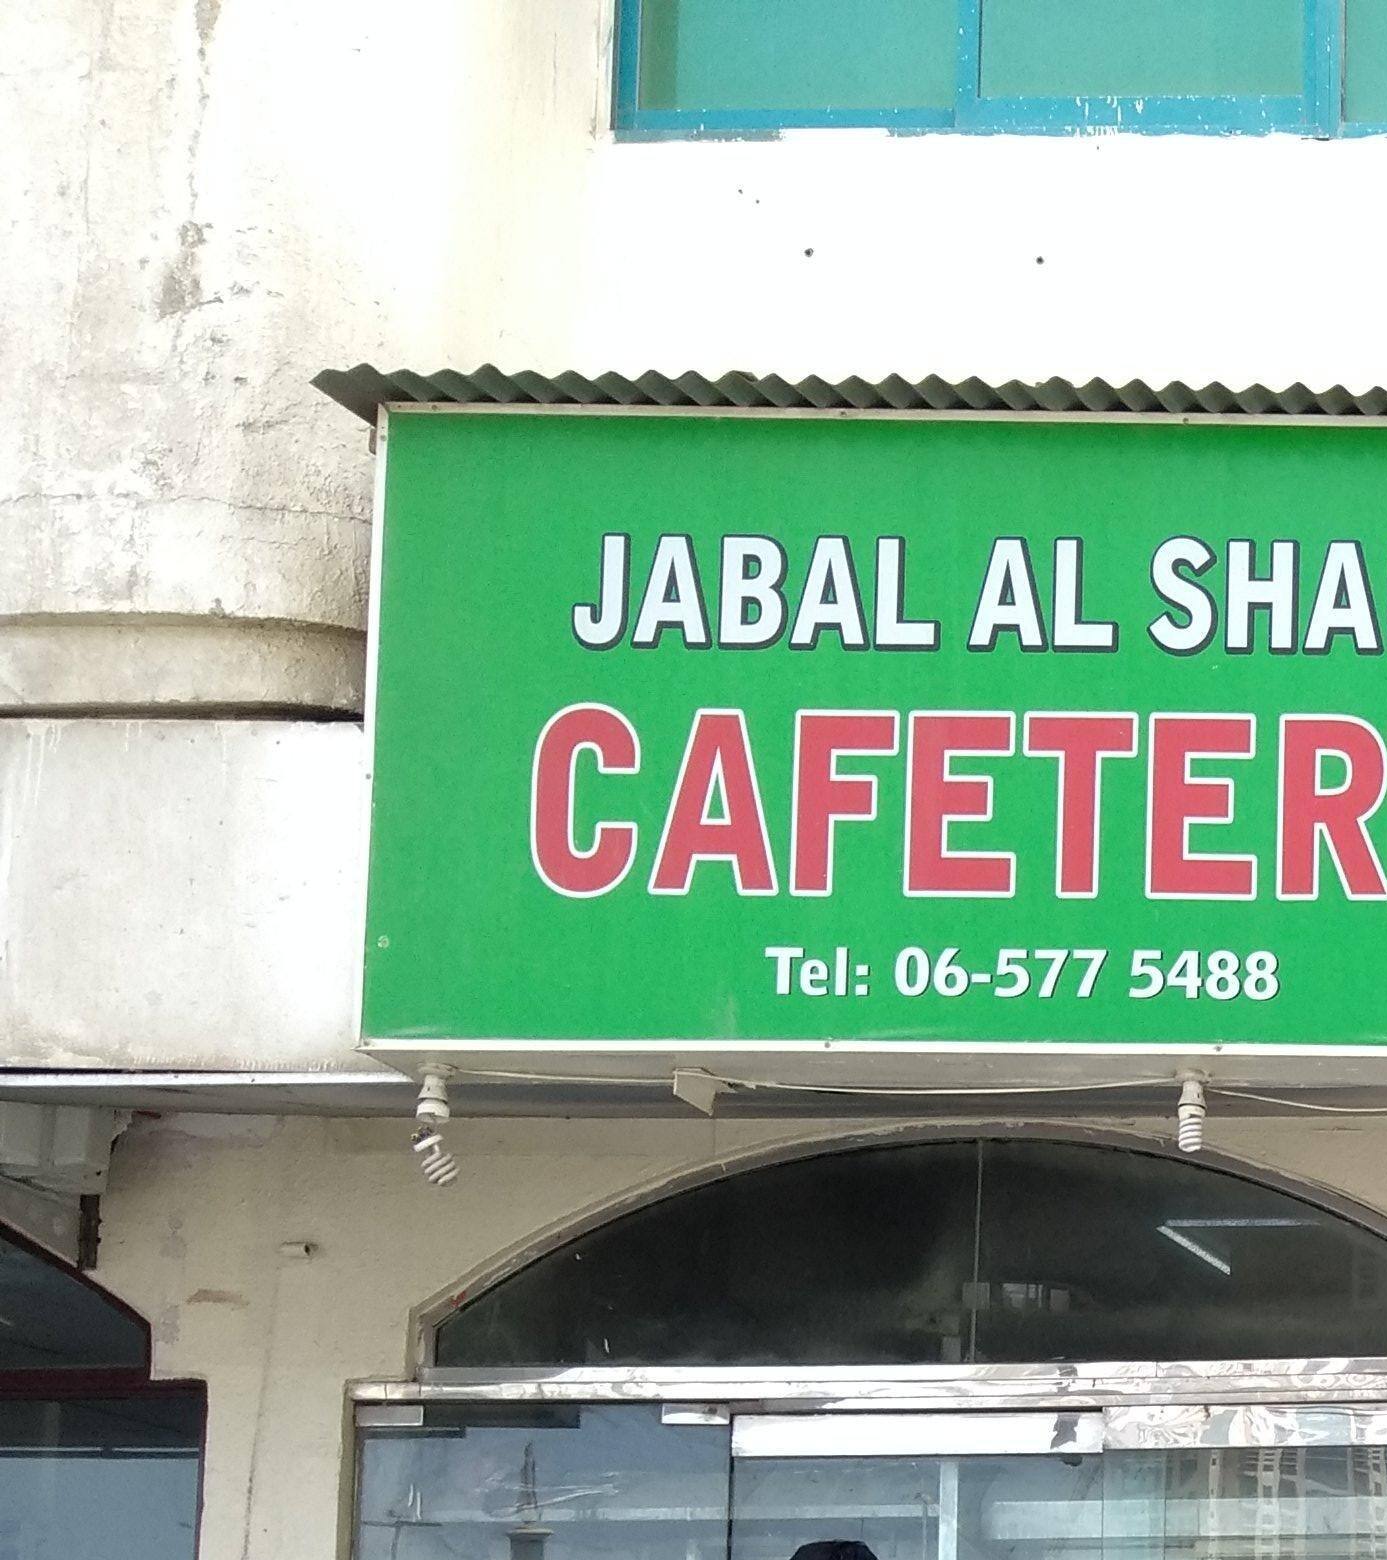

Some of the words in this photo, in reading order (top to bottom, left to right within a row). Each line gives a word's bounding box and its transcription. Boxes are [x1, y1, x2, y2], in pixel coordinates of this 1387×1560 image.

[572, 532, 941, 652] JABAL
[966, 536, 1119, 653] AL
[764, 946, 871, 998] Tel:
[894, 946, 1109, 999] 06-577
[1127, 949, 1281, 1001] 5488
